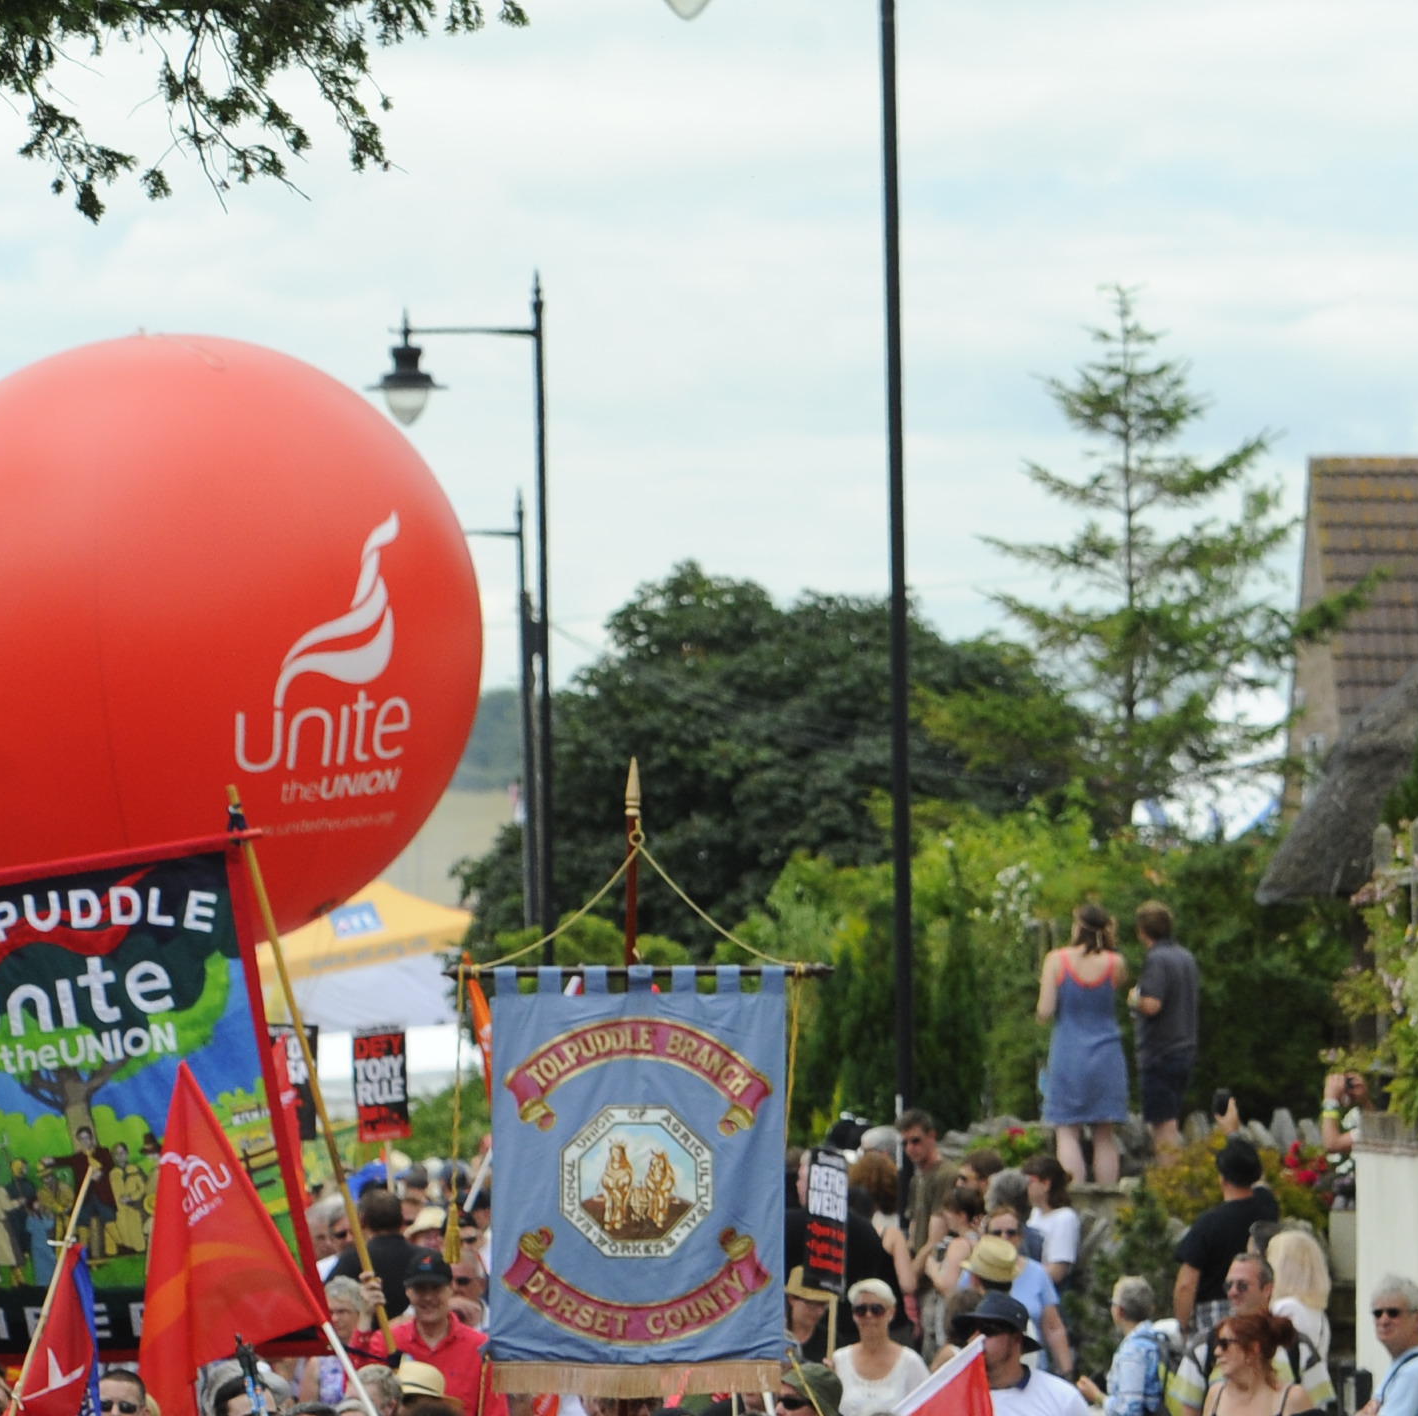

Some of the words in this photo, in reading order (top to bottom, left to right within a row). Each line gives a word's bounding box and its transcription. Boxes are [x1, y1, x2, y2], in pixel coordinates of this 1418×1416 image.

[234, 690, 411, 774] unite
[525, 1026, 655, 1089] TOLPUDDLE
[665, 1032, 753, 1099] BRANCH
[575, 1109, 616, 1150] UNION
[627, 1106, 648, 1119] OF
[525, 1270, 629, 1338] DORSET
[645, 1270, 755, 1338] COUNTY
